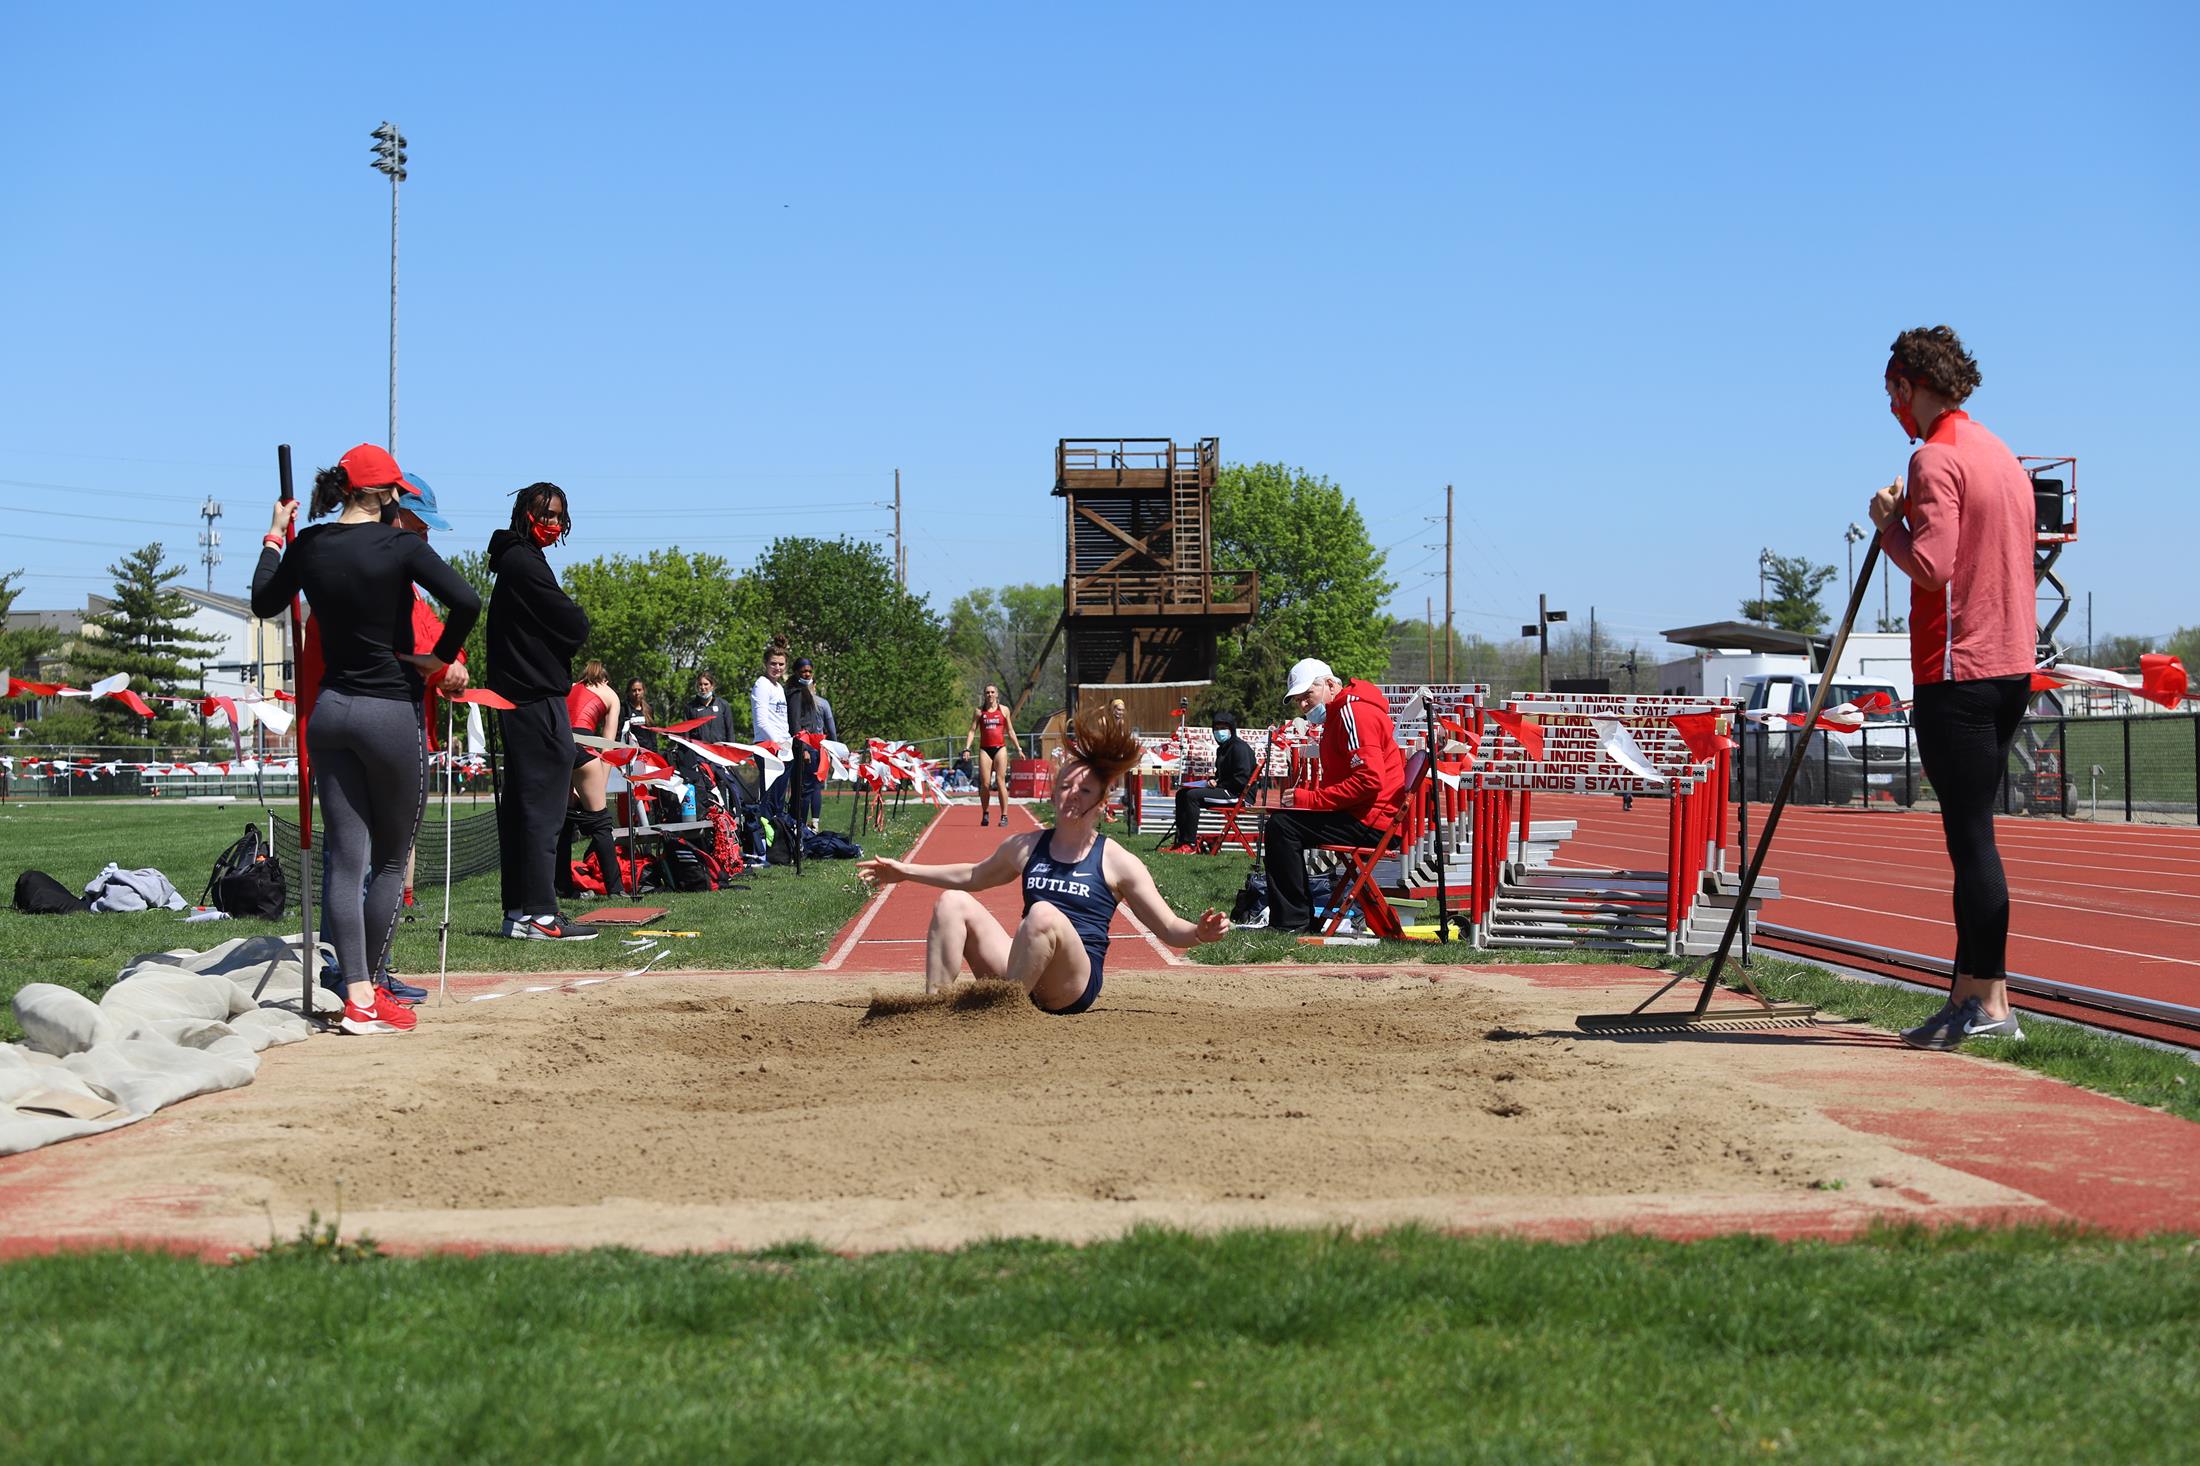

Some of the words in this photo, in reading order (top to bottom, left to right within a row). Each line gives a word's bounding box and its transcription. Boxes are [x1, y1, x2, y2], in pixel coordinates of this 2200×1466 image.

[1632, 705, 1669, 717] STATE
[1504, 774, 1576, 789] ILLINOIS
[1584, 776, 1645, 791] STATE
[1026, 877, 1091, 898] BUTLER
